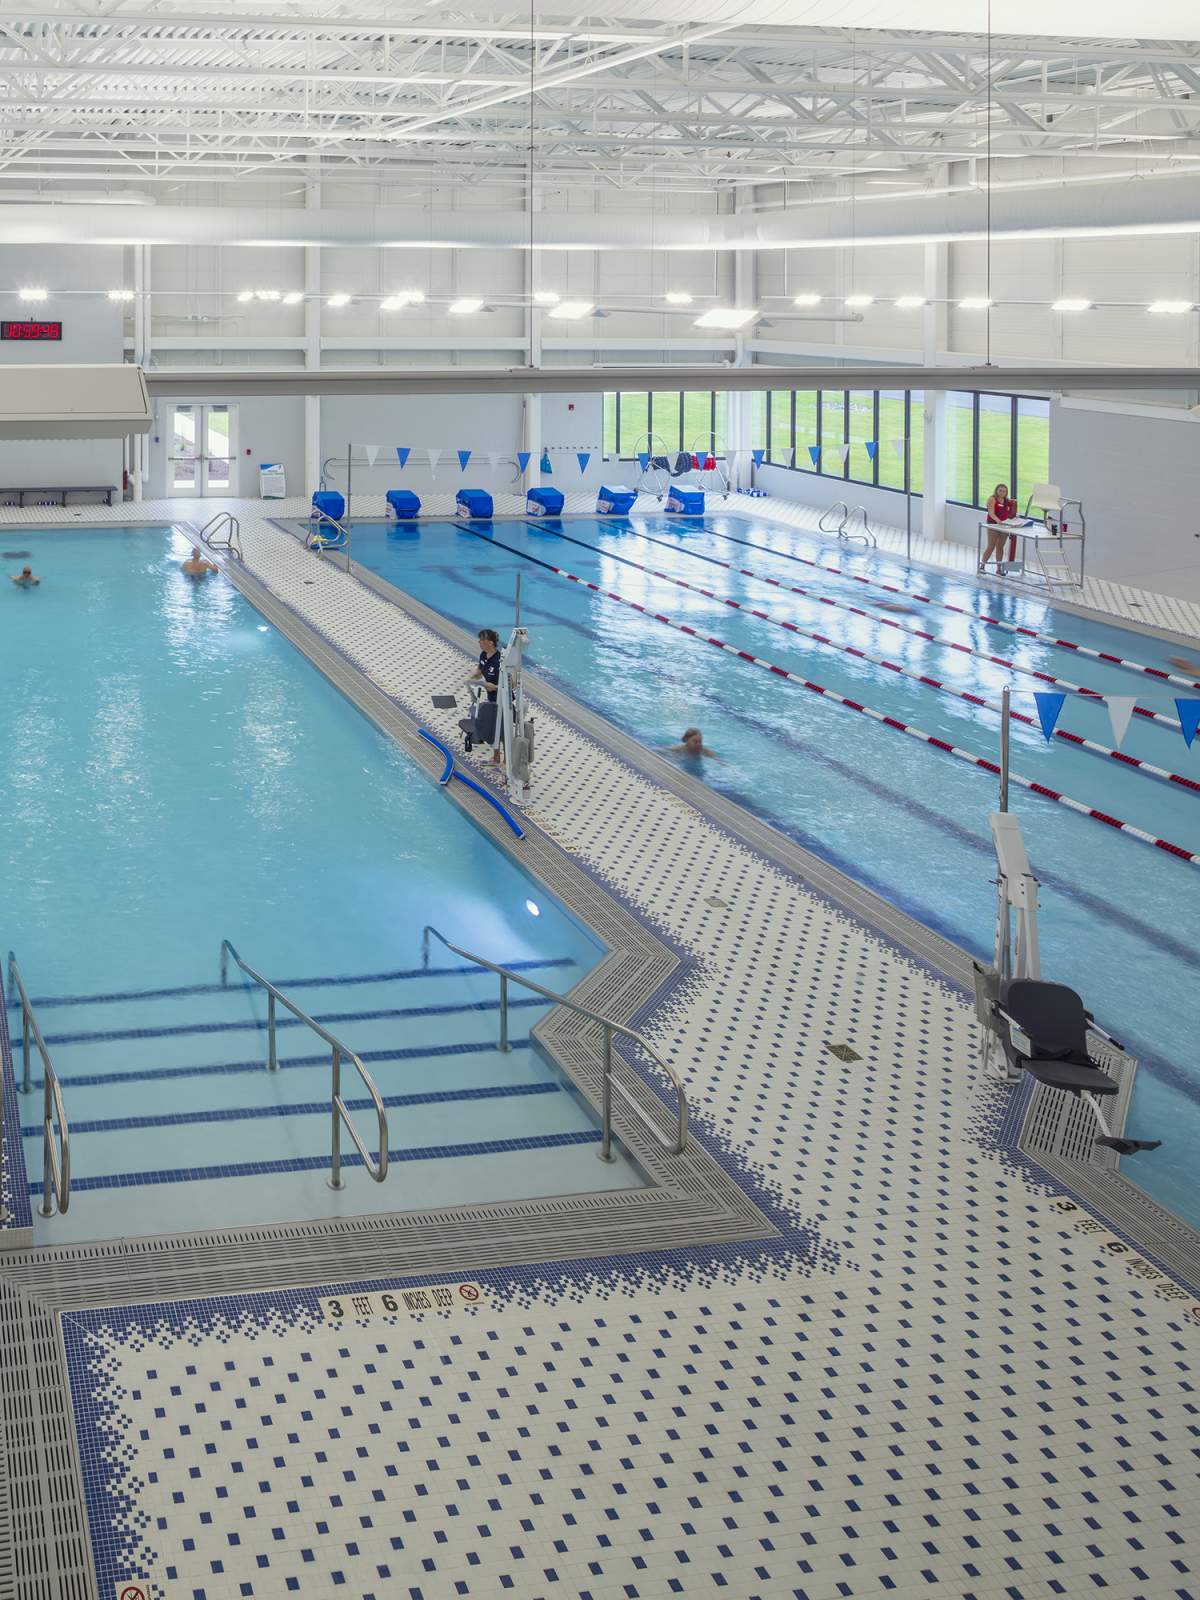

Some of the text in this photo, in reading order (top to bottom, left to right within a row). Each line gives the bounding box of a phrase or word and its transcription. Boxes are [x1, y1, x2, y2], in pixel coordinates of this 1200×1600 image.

[1056, 1201, 1189, 1301] 3 FEET 6 INCHES DEEP
[328, 1287, 454, 1318] 3 FEET 6 INCHES DEEP
